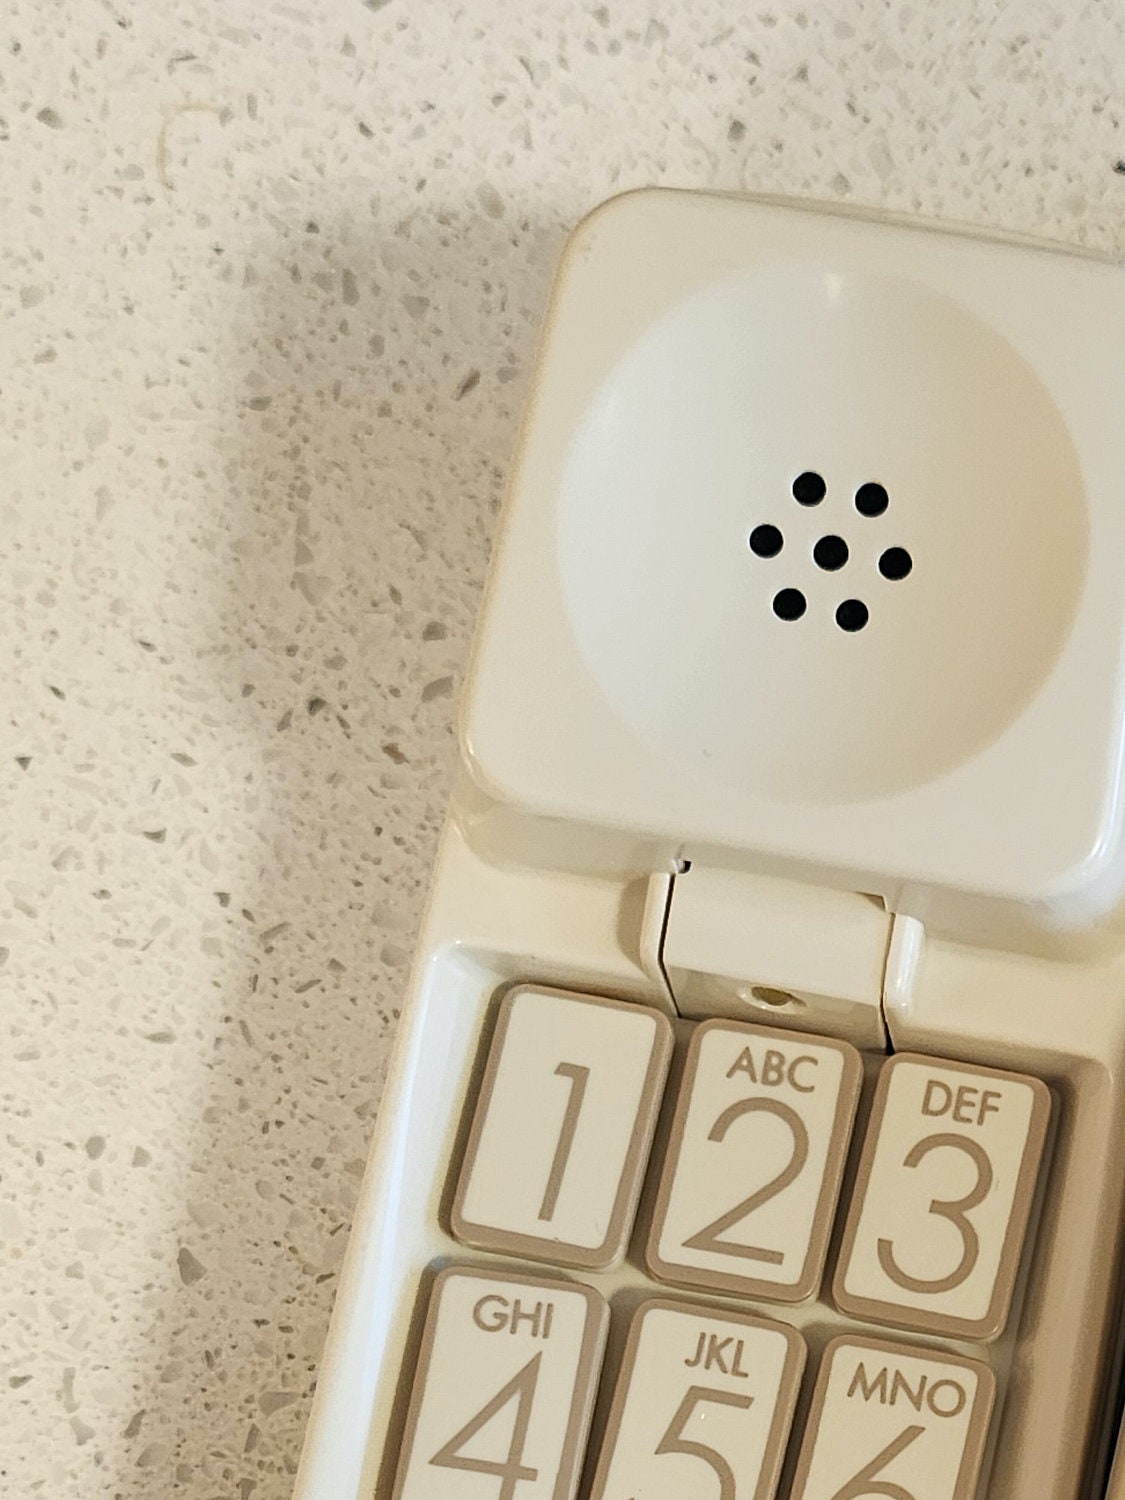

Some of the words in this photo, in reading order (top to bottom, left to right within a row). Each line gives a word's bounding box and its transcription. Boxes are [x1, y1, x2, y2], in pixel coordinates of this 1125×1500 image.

[727, 1046, 819, 1093] ABC
[921, 1079, 1002, 1127] DEF
[537, 1061, 590, 1221] 1
[681, 1097, 809, 1265] 2
[876, 1133, 993, 1293] 3
[473, 1294, 554, 1339] GHI
[684, 1332, 749, 1378] JKL
[847, 1362, 966, 1418] MNO
